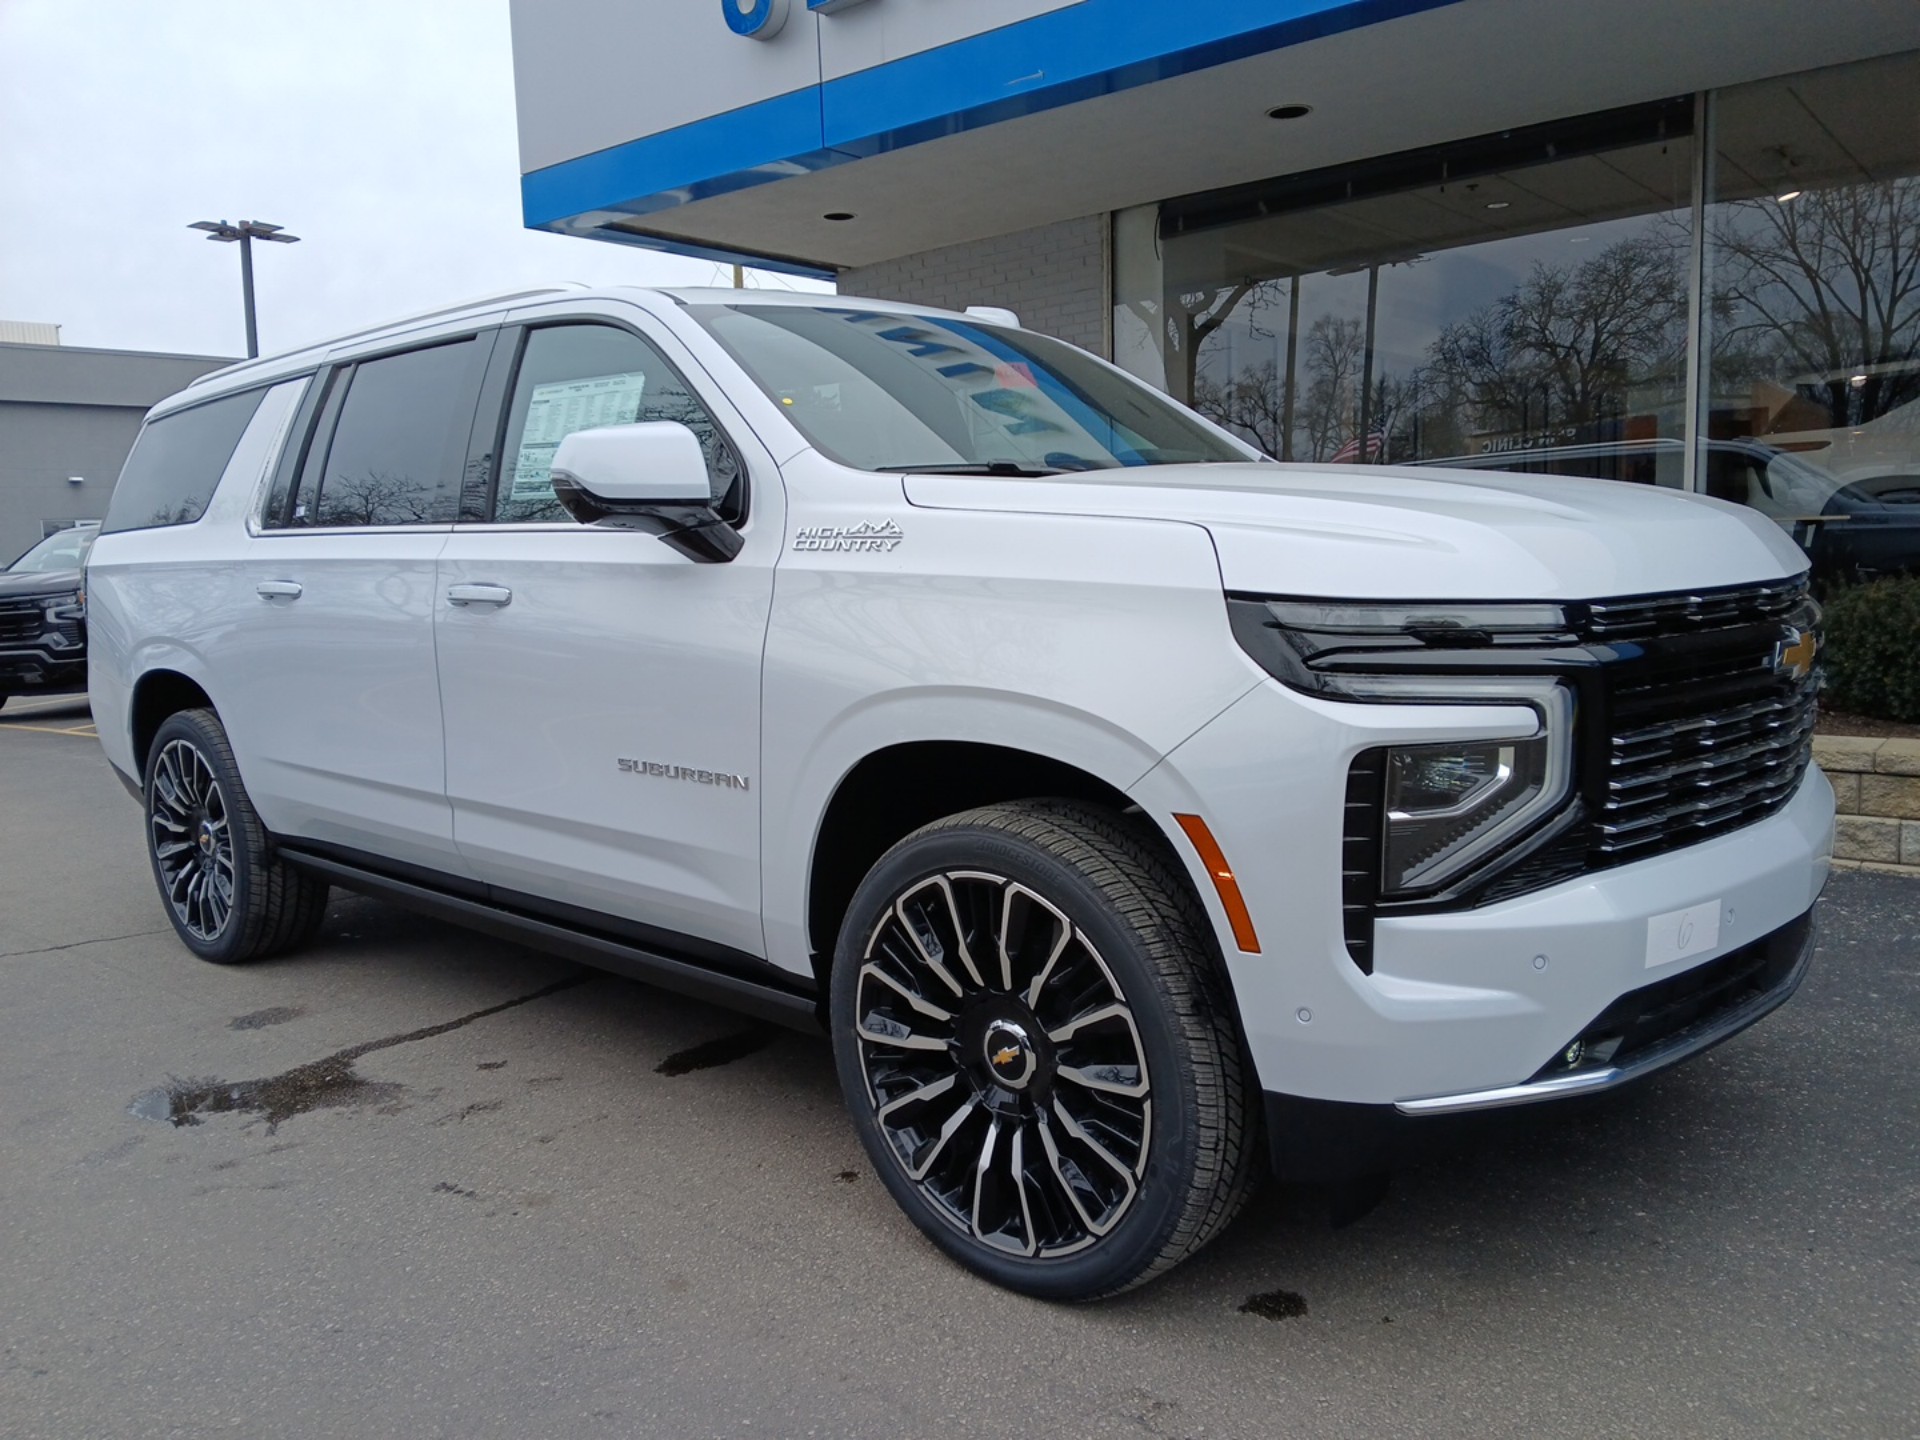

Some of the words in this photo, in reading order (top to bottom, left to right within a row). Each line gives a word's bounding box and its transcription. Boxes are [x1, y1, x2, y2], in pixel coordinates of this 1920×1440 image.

[792, 539, 902, 552] COUNTRY
[795, 527, 850, 540] HIGH
[617, 757, 749, 792] SUBURBAN
[1676, 912, 1694, 950] 6
